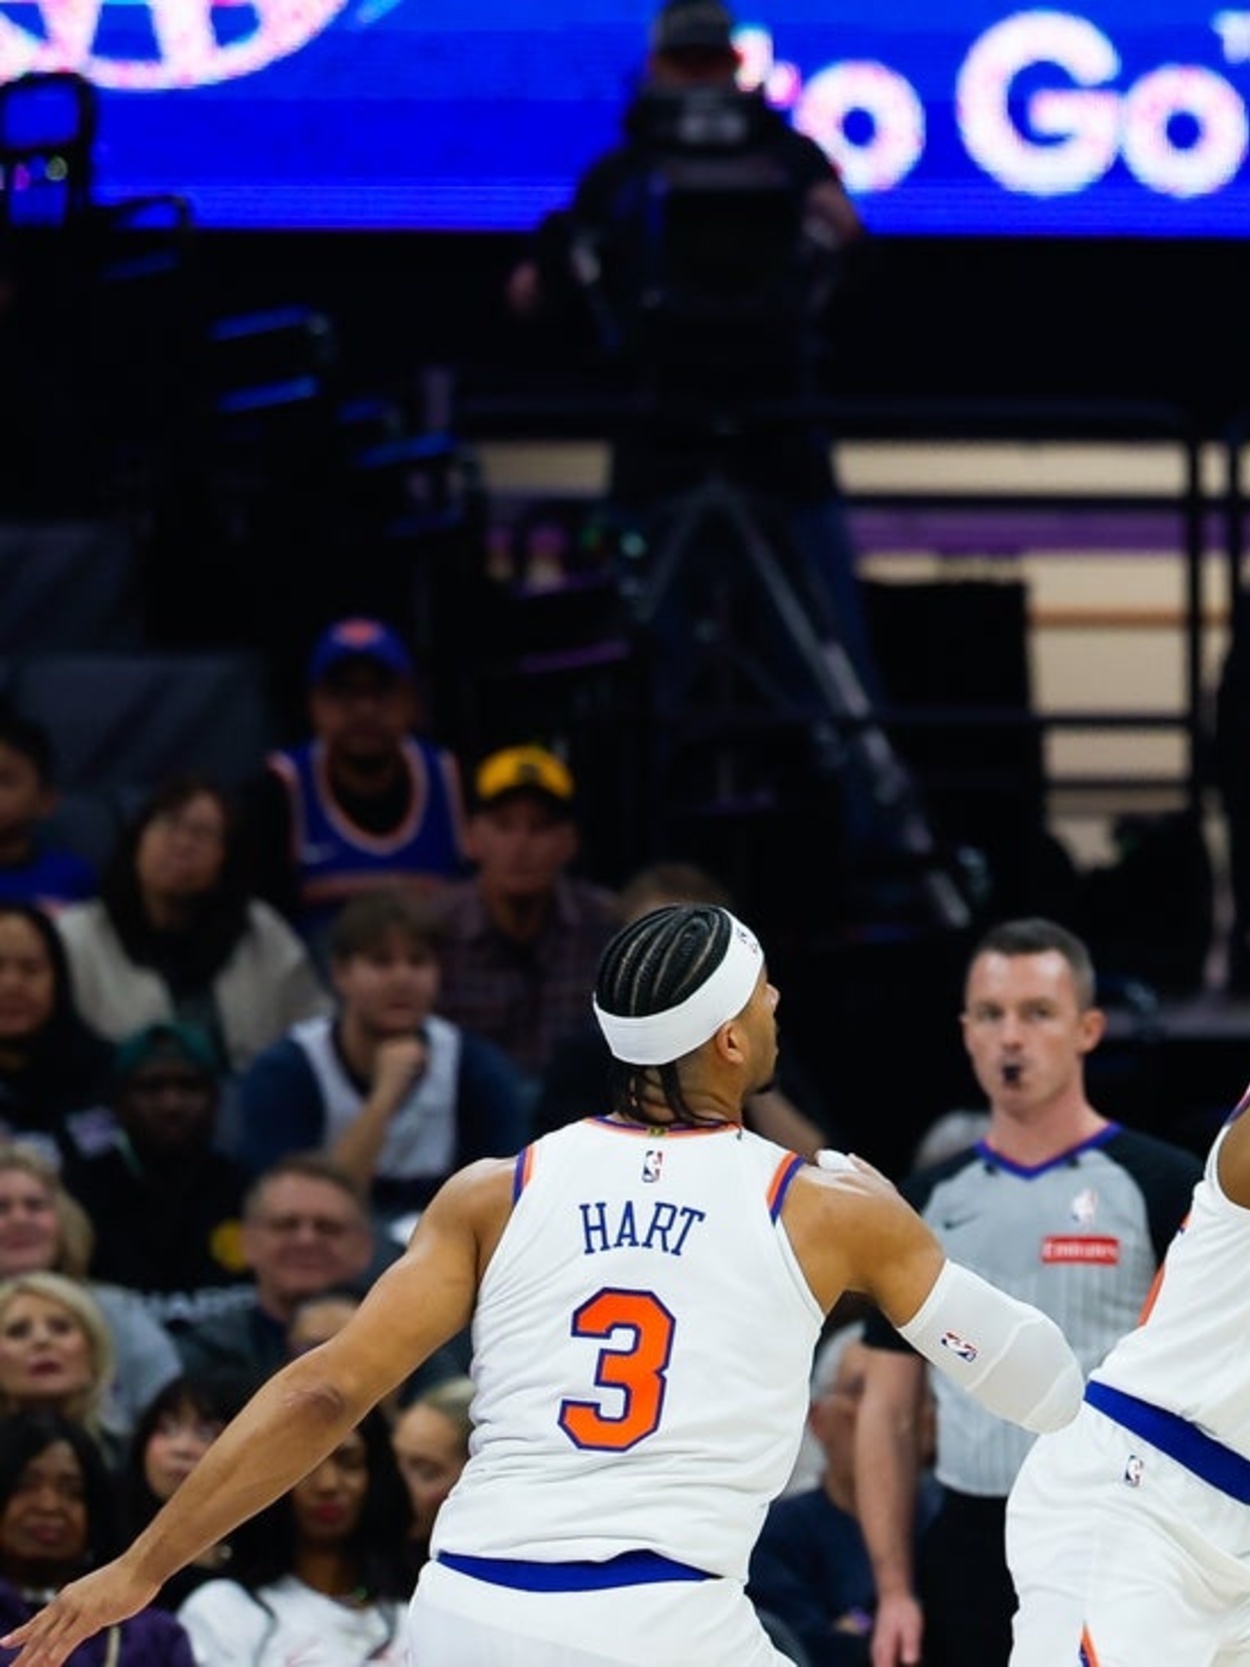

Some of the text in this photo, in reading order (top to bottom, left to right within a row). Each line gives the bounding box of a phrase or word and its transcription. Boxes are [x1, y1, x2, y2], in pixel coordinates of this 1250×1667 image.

[955, 9, 1250, 198] Go
[578, 1200, 707, 1256] HART
[557, 1287, 676, 1453] 3
